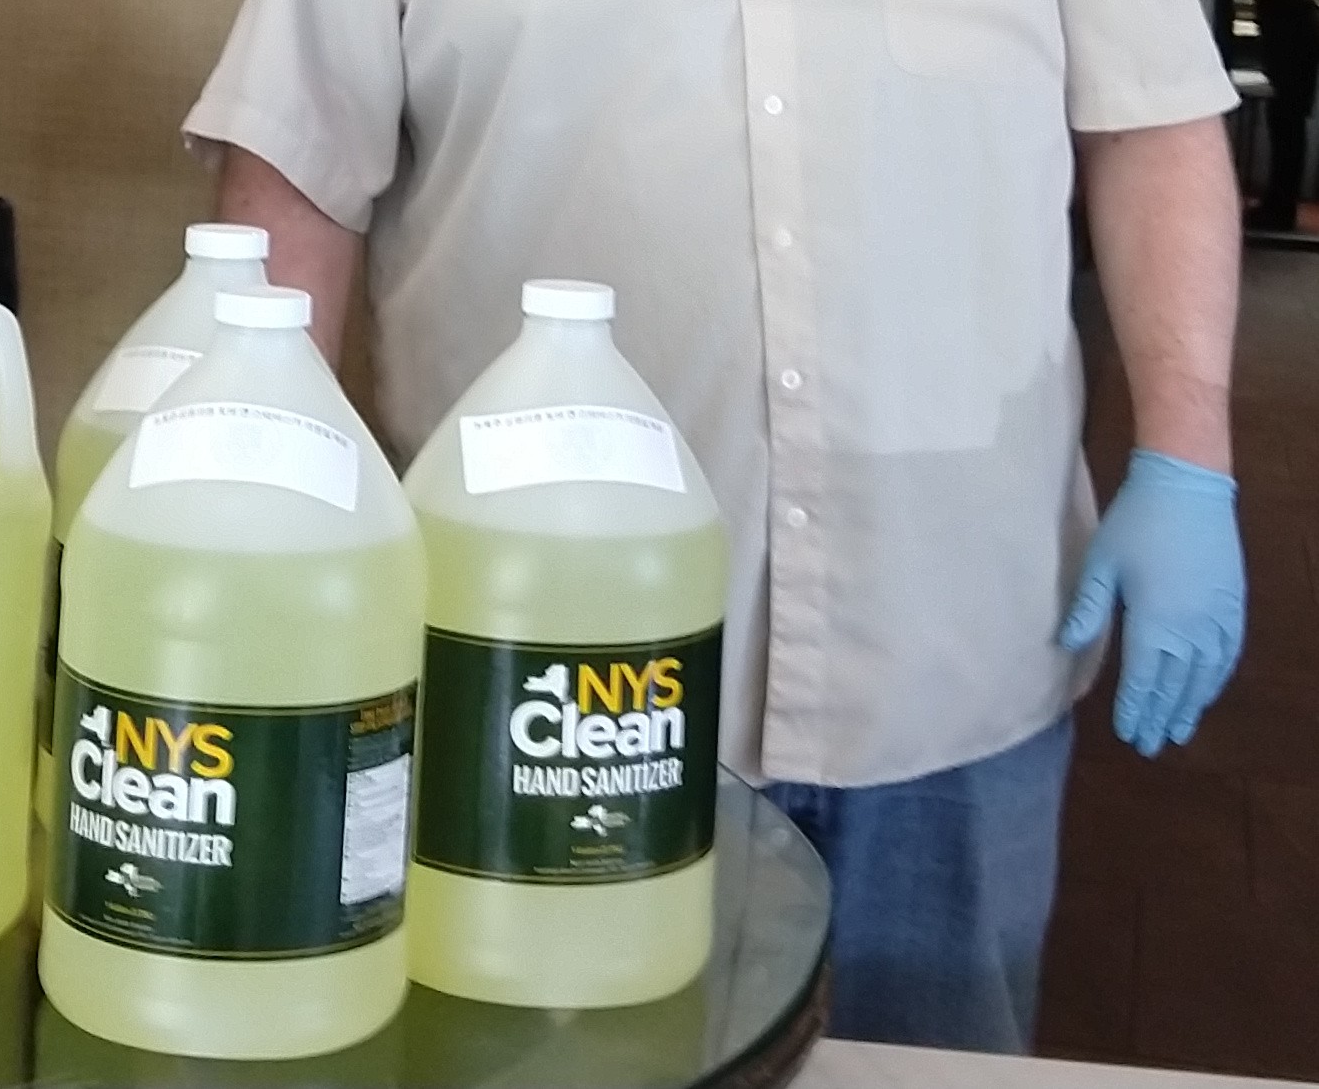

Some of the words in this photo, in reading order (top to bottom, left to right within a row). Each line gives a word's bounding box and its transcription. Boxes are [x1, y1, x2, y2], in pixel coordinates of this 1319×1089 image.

[577, 656, 683, 715] NYS
[115, 710, 234, 778] NYS
[509, 698, 686, 759] Clean
[70, 738, 237, 826] Clean
[512, 763, 581, 798] HAND
[581, 756, 683, 798] SANITIZER
[69, 800, 115, 849] HAND
[114, 817, 233, 868] SANITIZER
